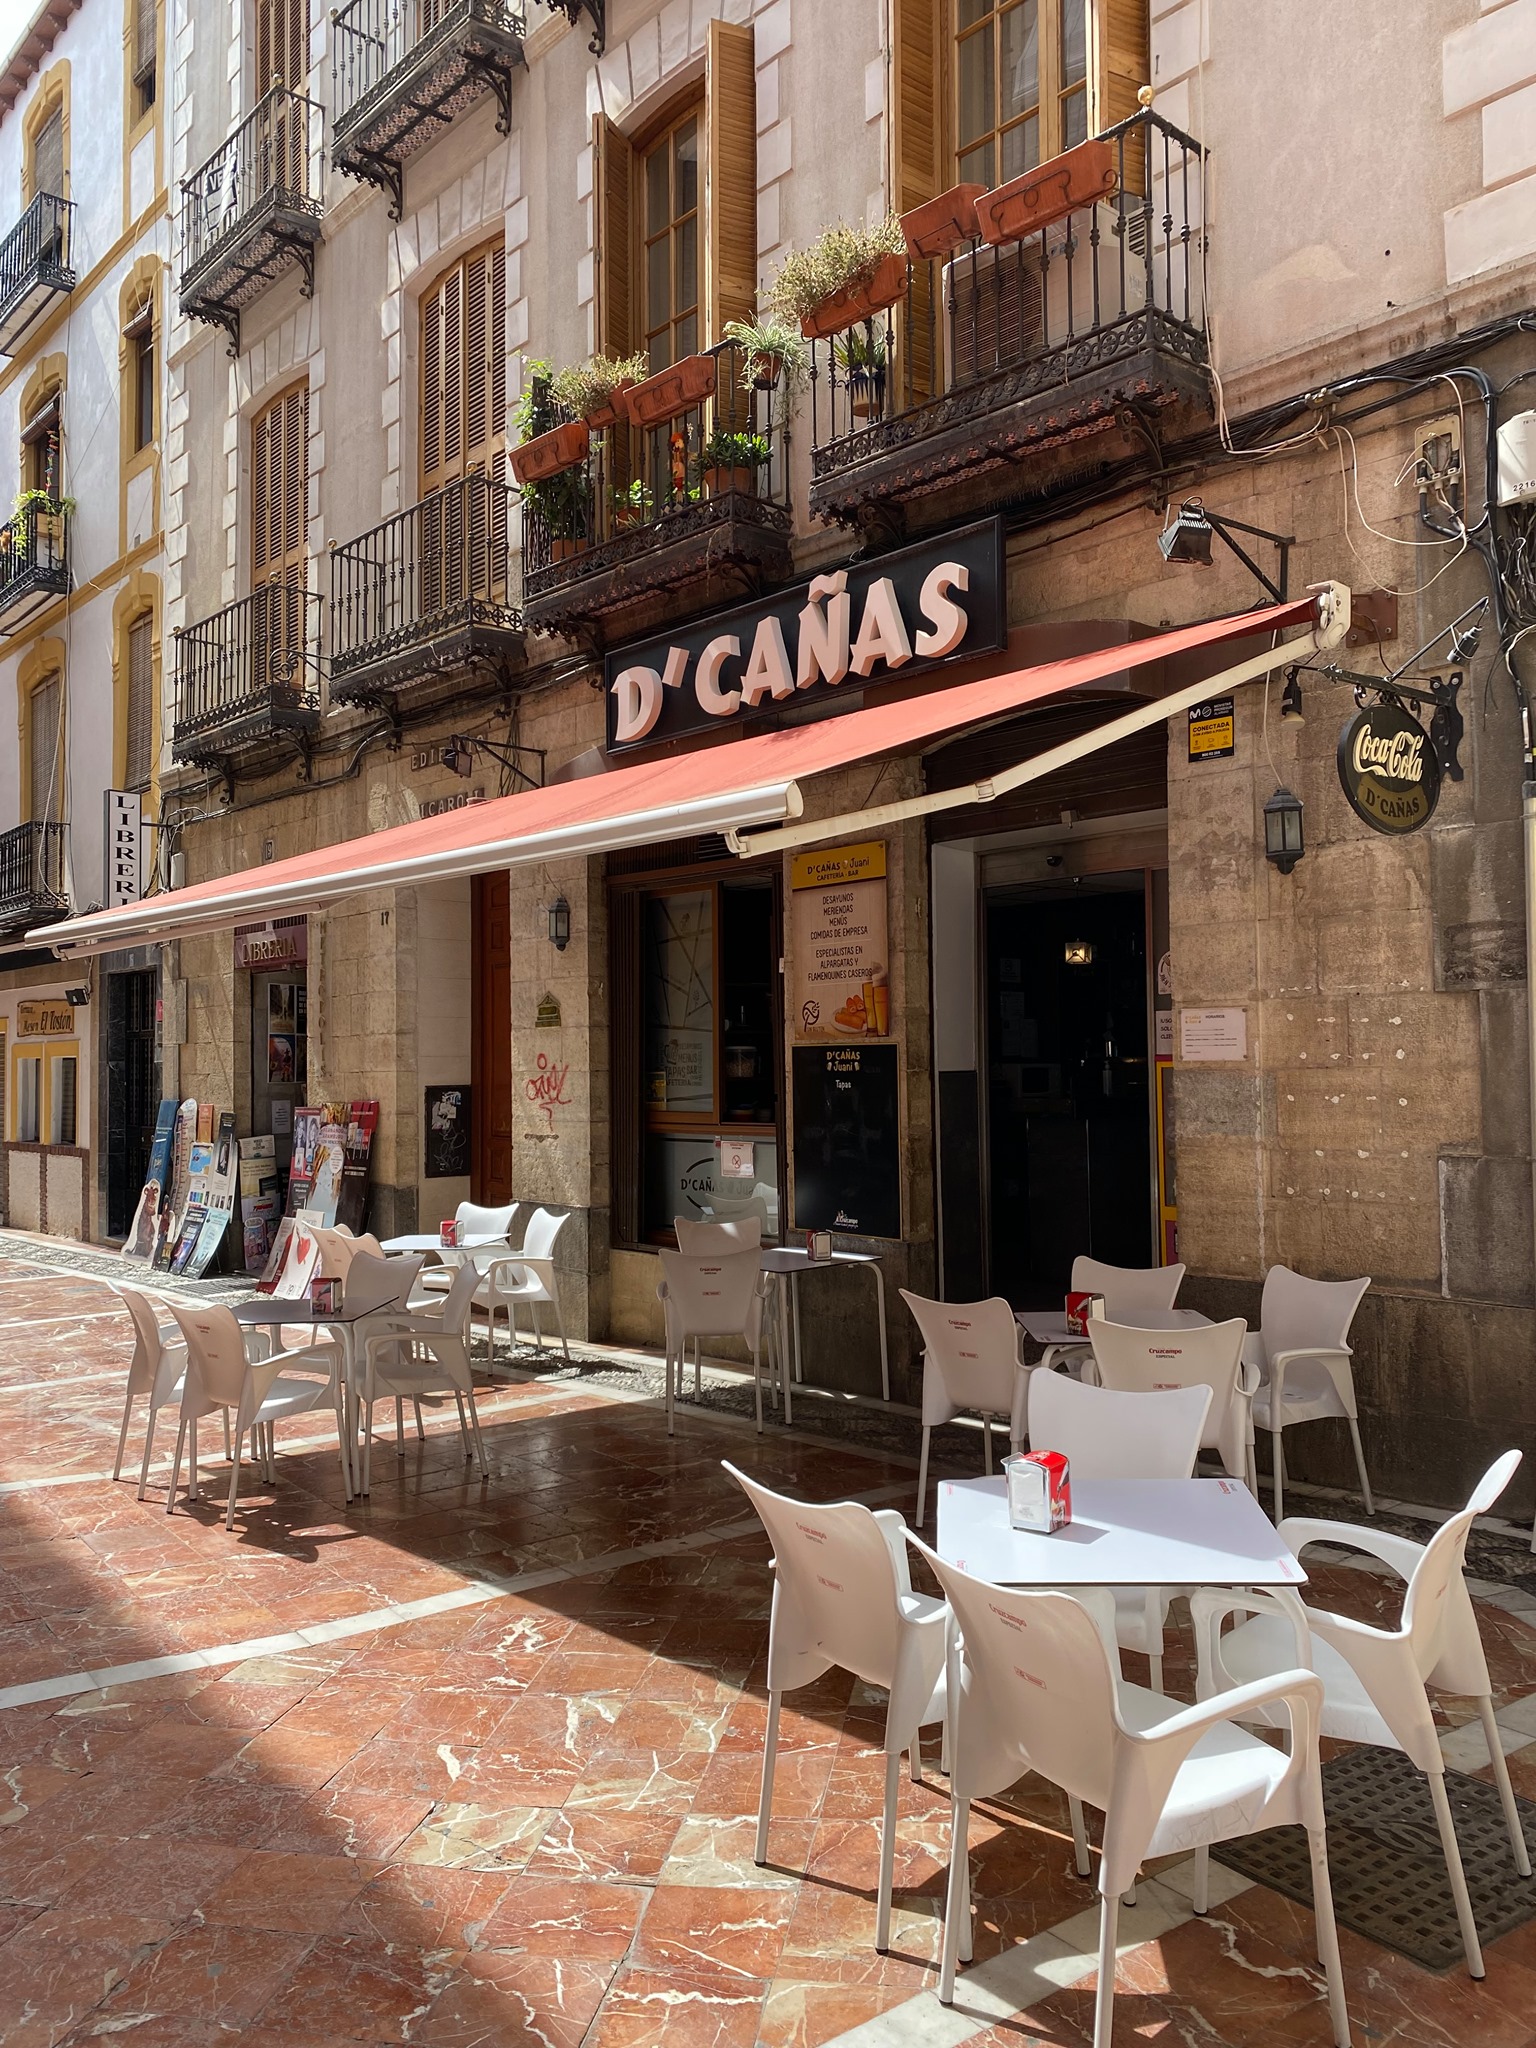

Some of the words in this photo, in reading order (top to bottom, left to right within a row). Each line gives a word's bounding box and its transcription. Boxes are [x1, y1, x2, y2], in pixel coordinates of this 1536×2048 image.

[610, 561, 970, 743] D'CAÑAS
[1192, 721, 1230, 733] CONECTADA
[1353, 723, 1425, 783] Coca-Cola
[807, 860, 841, 875] D'CAÑAS
[849, 856, 870, 870] Juani
[848, 869, 859, 877] BAR
[822, 892, 854, 905] DESAYUNOS
[823, 904, 854, 916] MERIENDAS
[381, 911, 390, 926] 17
[829, 914, 848, 927] MENÚS
[810, 929, 833, 940] COMIDAS
[834, 928, 843, 938] DE
[843, 927, 868, 937] EMPRESA
[815, 946, 854, 958] ESPECIALISTAS
[855, 946, 863, 954] EN
[820, 959, 854, 969] ALPARGATAS
[854, 958, 859, 967] Y
[808, 970, 847, 982] FLAMENQUINES
[847, 967, 873, 979] CASEROS
[40, 1011, 49, 1031] El
[826, 1048, 861, 1061] D'CAÑAS
[833, 1060, 853, 1072] Juani
[835, 1079, 852, 1091] Tapas
[1148, 1347, 1182, 1355] Cruzcampo
